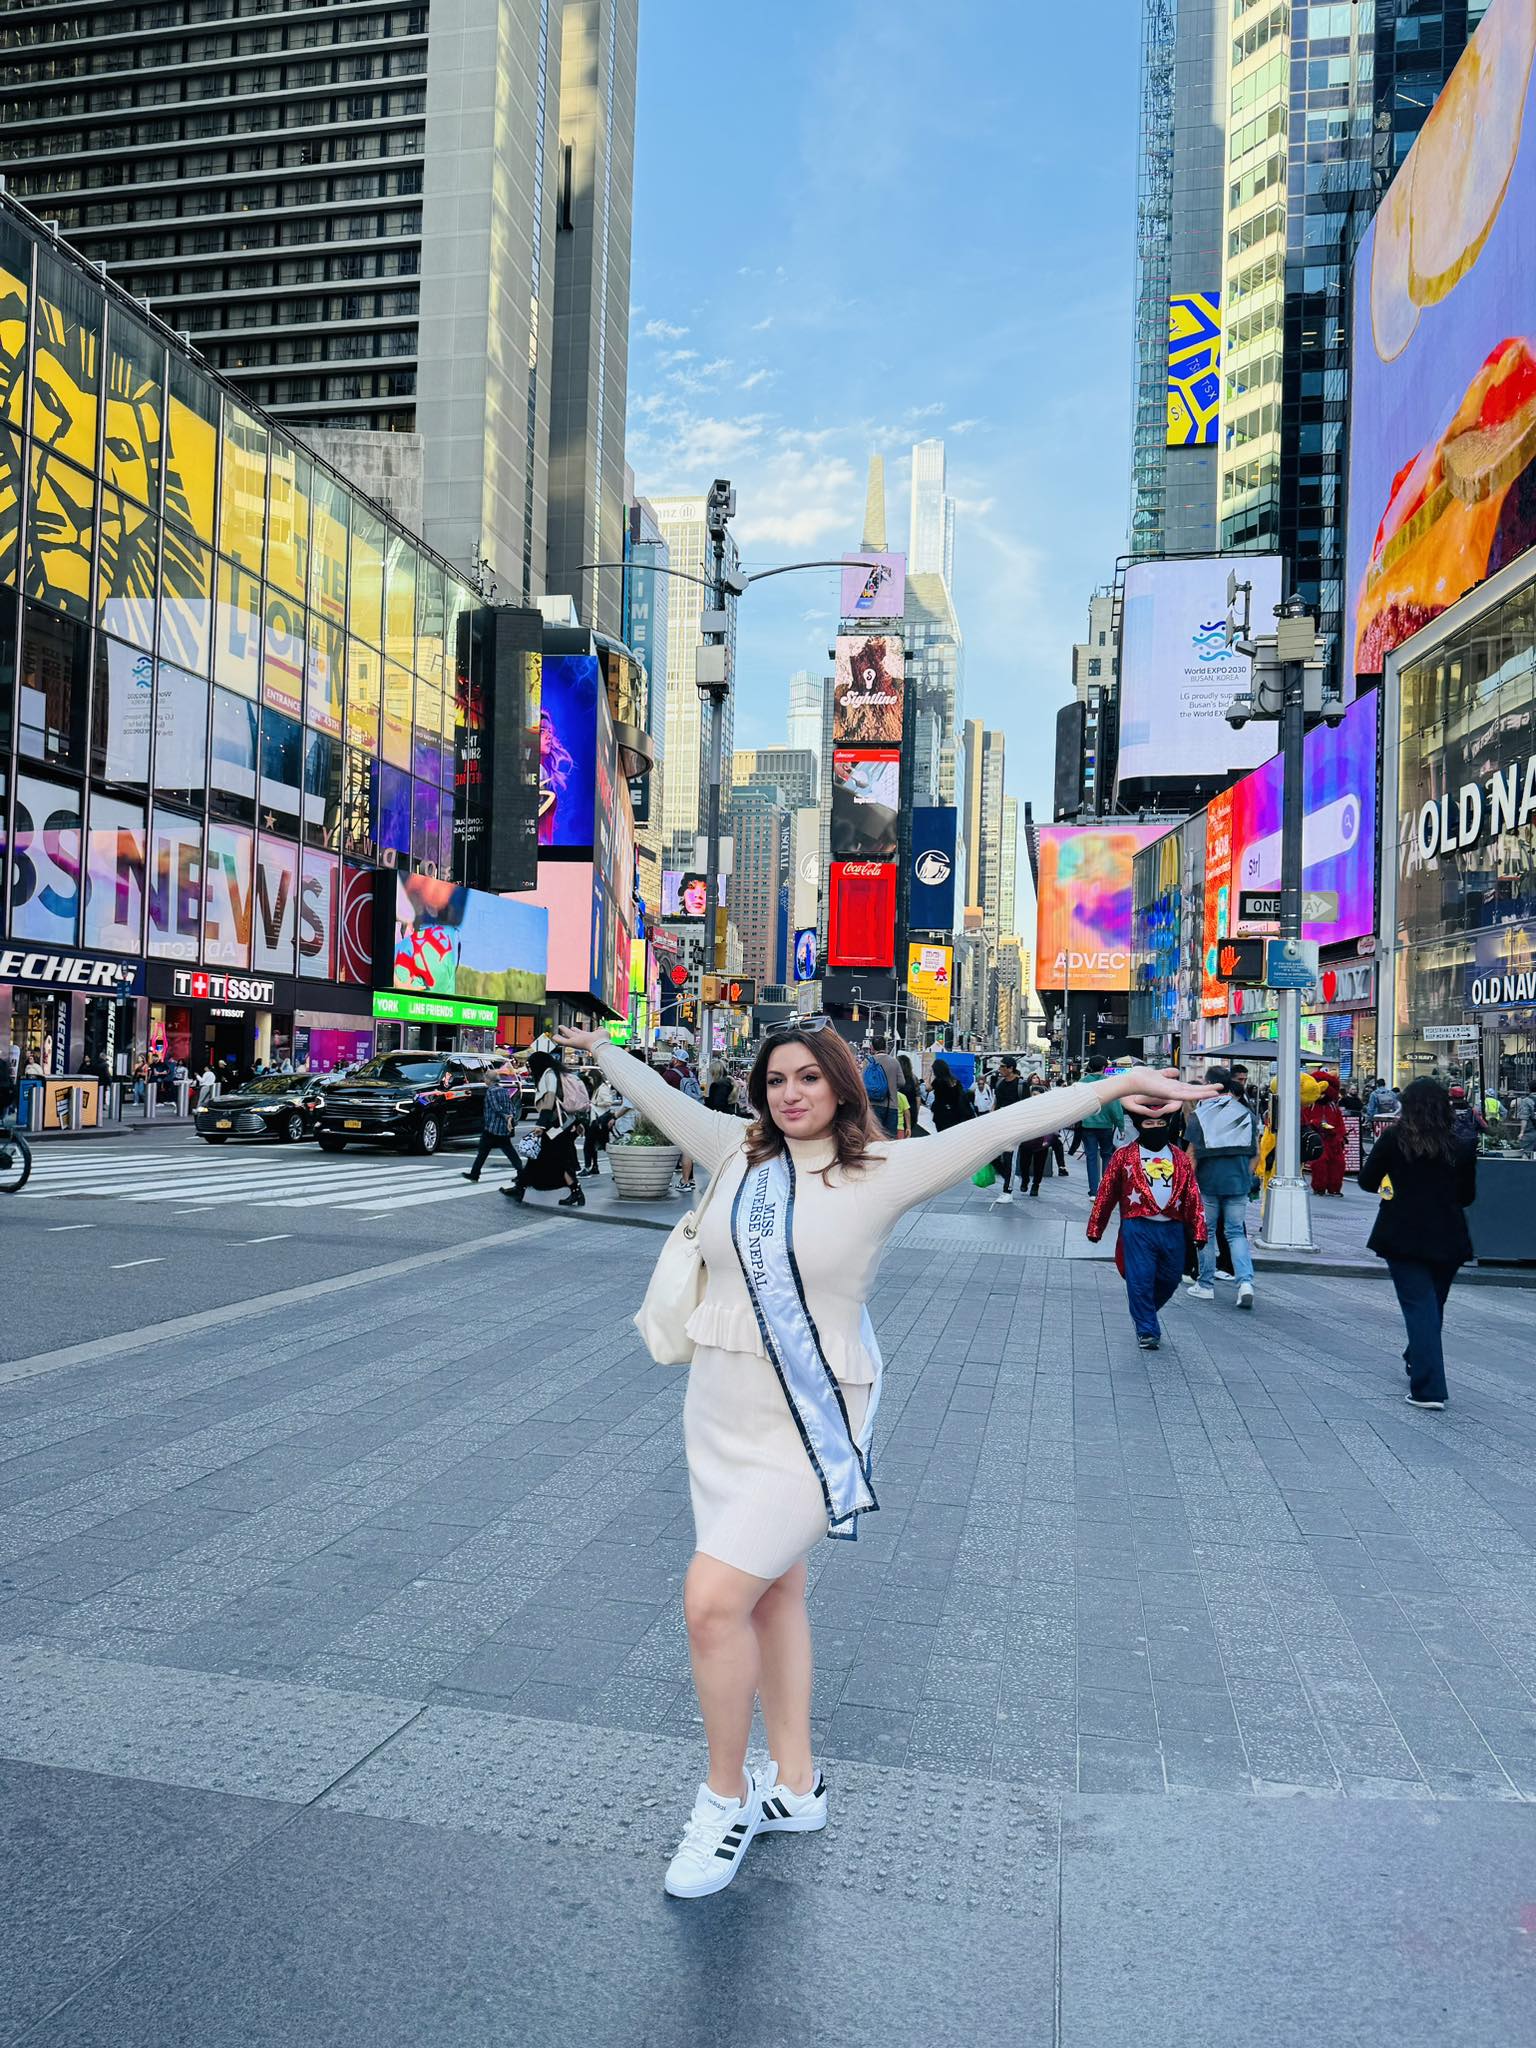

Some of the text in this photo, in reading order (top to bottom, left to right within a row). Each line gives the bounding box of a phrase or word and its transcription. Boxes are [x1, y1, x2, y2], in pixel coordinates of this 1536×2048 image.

[1184, 666, 1247, 675] World EXPO 2030
[266, 687, 302, 713] ENTRANCE
[840, 690, 898, 708] Sightline
[1180, 692, 1190, 700] LG
[1191, 692, 1219, 701] proudly
[1189, 701, 1217, 709] Busan's
[1193, 710, 1214, 718] World
[1418, 782, 1482, 860] OLD
[115, 826, 325, 957] NEWS
[1253, 901, 1323, 912] ONE AY
[211, 977, 273, 1002] TISSOT
[1472, 976, 1501, 1006] OLD
[376, 998, 495, 1021] YORK LINE FRIENDS NEW YORK
[748, 1167, 769, 1291] UNIVERSE NEPAL
[761, 1201, 776, 1238] MISS
